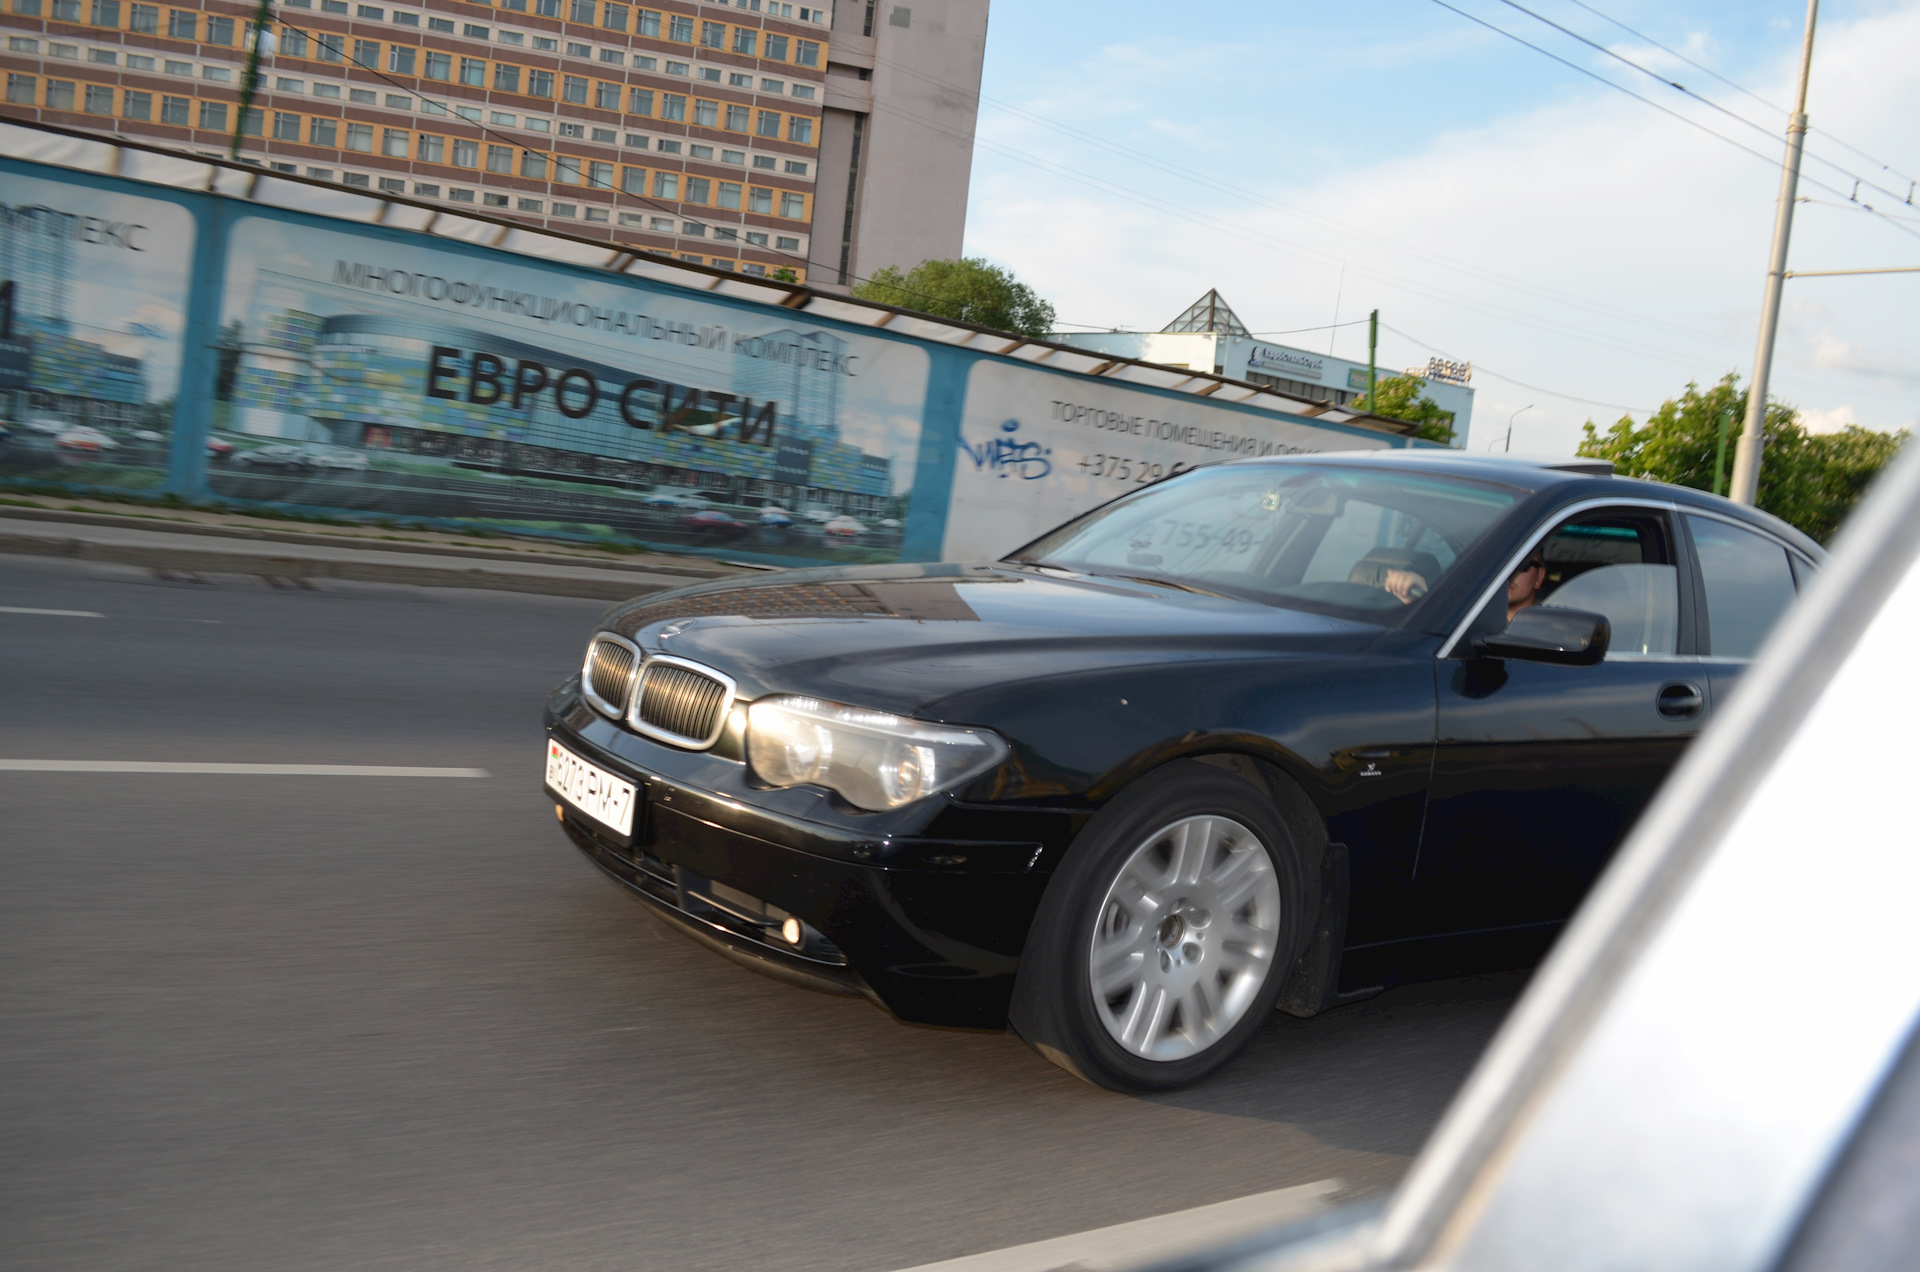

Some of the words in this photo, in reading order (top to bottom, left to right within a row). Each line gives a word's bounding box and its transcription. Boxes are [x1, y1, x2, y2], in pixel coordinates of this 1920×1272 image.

[333, 260, 727, 352] МНОГОФУНКЦИОНАЛЬНЫЙ
[734, 334, 859, 377] КОМПЛЕКС
[427, 344, 598, 420] ЕВРО
[620, 378, 777, 447] СИТИ
[1051, 400, 1142, 437] ТОРГОВЫЕ
[1146, 418, 1257, 455] ПОМЕЩЕНИЯ
[1259, 440, 1273, 459] И
[1076, 454, 1132, 480] +375
[1134, 462, 1163, 483] 29
[588, 770, 631, 826] PM-7
